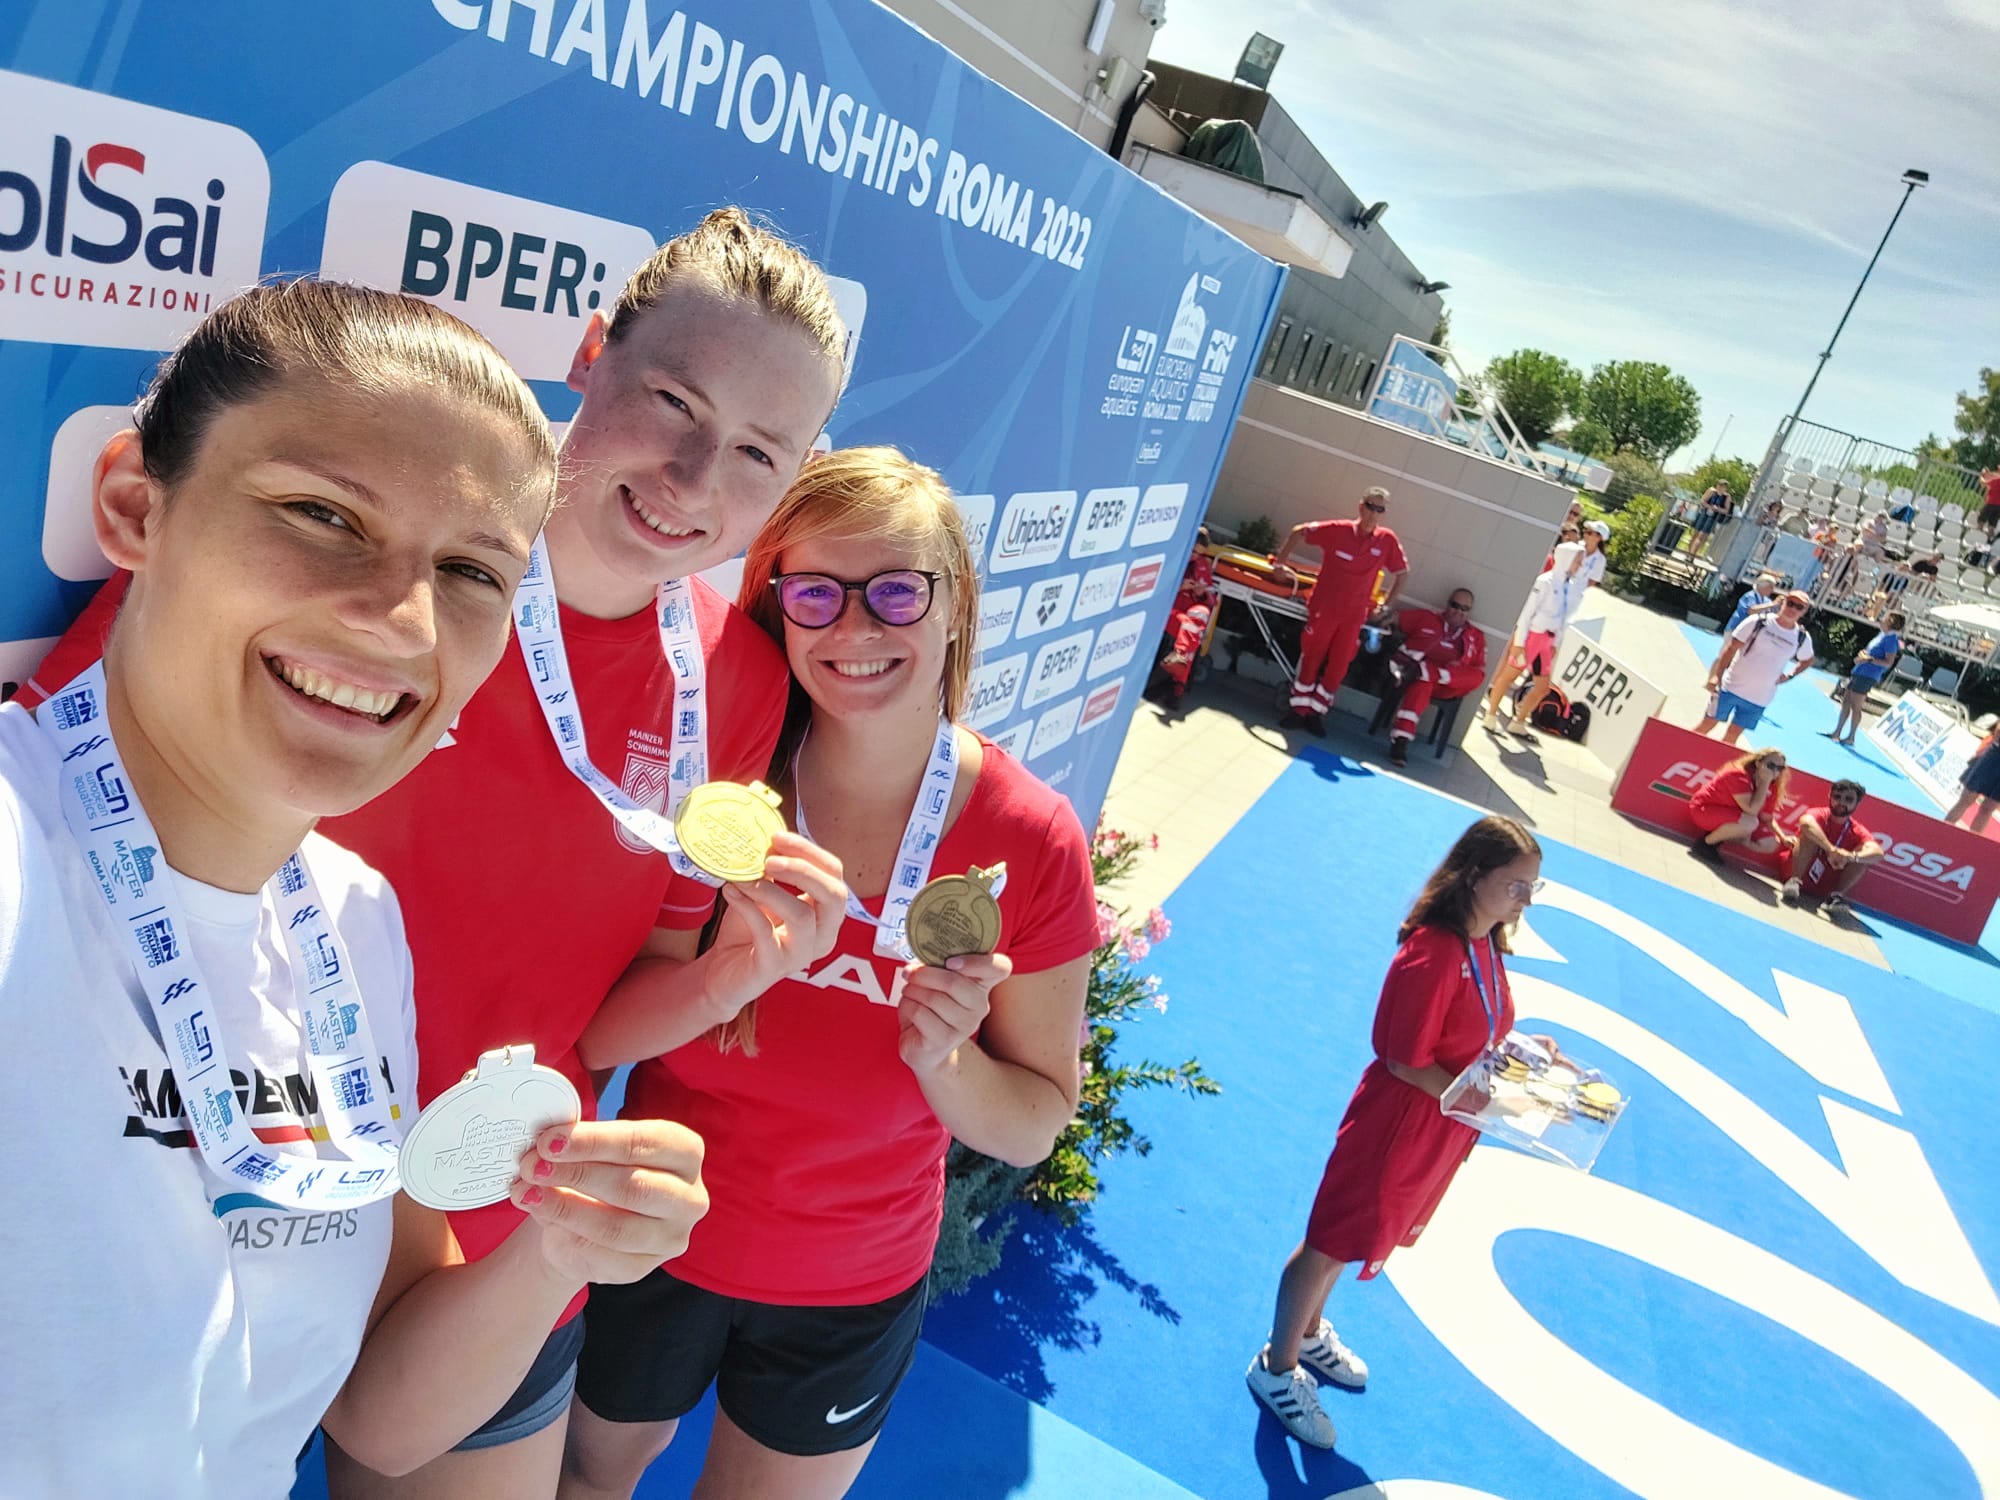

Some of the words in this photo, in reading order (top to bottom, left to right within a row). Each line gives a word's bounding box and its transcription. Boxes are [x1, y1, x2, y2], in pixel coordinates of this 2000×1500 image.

[935, 150, 1034, 248] ROMA
[1031, 197, 1092, 271] 2022
[1148, 378, 1189, 402] AQUATICS
[1007, 505, 1069, 555] UnipolSai
[531, 595, 543, 634] MASTER
[533, 649, 550, 682] LEN
[673, 649, 689, 678] LEN
[1562, 645, 1633, 716] BPER:
[51, 699, 69, 731] NUOTO
[60, 697, 76, 728] ITALIANA
[629, 729, 663, 746] MAINZER
[74, 776, 97, 820] aquatics
[85, 771, 109, 817] european
[95, 762, 130, 814] LEN
[88, 850, 104, 882] ROMA
[101, 882, 118, 905] 2022
[113, 839, 145, 900] MASTER
[134, 927, 156, 969] NUOTO
[142, 925, 162, 966] ITALIANA
[317, 932, 340, 977] LEN
[174, 1021, 194, 1071] aquatics
[182, 1018, 200, 1066] european
[190, 1010, 213, 1062] LEN
[304, 1010, 316, 1036] ROMA
[310, 1036, 321, 1056] 2022
[326, 999, 346, 1051] MASTER
[339, 1073, 354, 1109] ITALIANA
[188, 1099, 201, 1129] ROMA
[198, 1128, 210, 1152] 2022
[203, 1087, 229, 1143] MASTER
[338, 1168, 386, 1184] LEN
[227, 1207, 359, 1250] ASTERS
